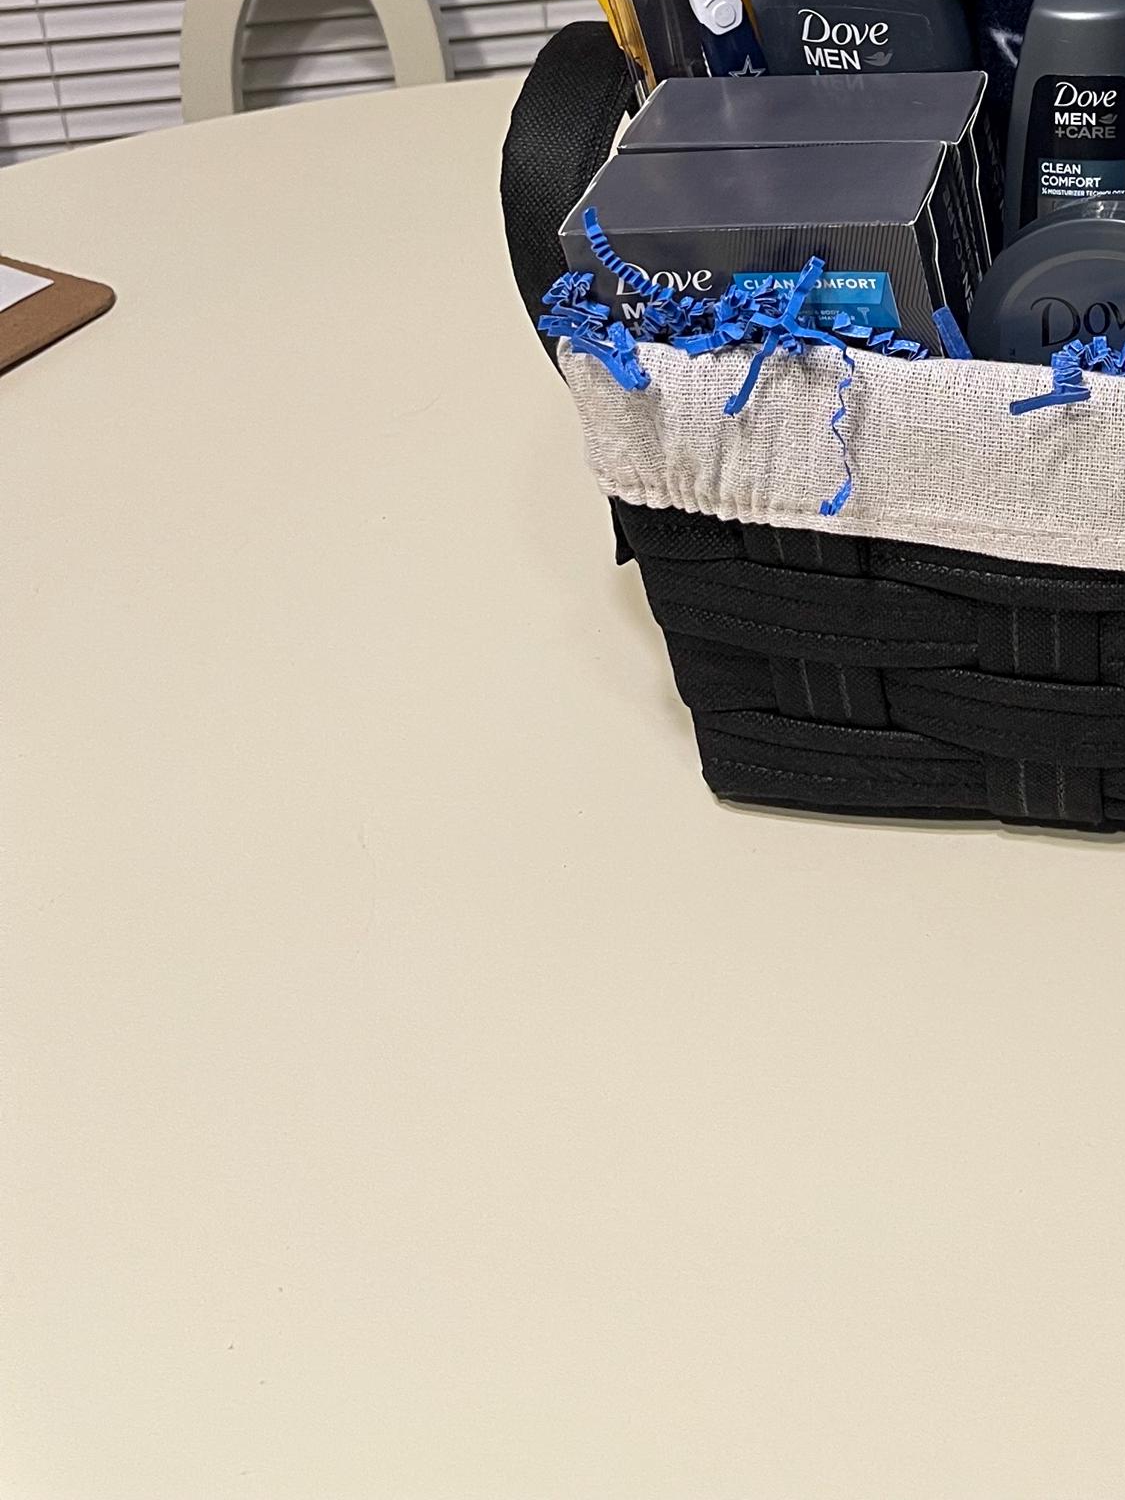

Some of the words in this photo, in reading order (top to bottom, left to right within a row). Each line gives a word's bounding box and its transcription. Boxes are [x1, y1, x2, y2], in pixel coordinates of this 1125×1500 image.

[797, 8, 889, 46] Dove
[803, 45, 862, 70] MEN
[1053, 81, 1118, 108] Dove
[1054, 111, 1097, 126] MEN
[1055, 126, 1117, 139] +CARE
[1041, 161, 1082, 175] CLEAN
[1041, 174, 1102, 188] COMFORT
